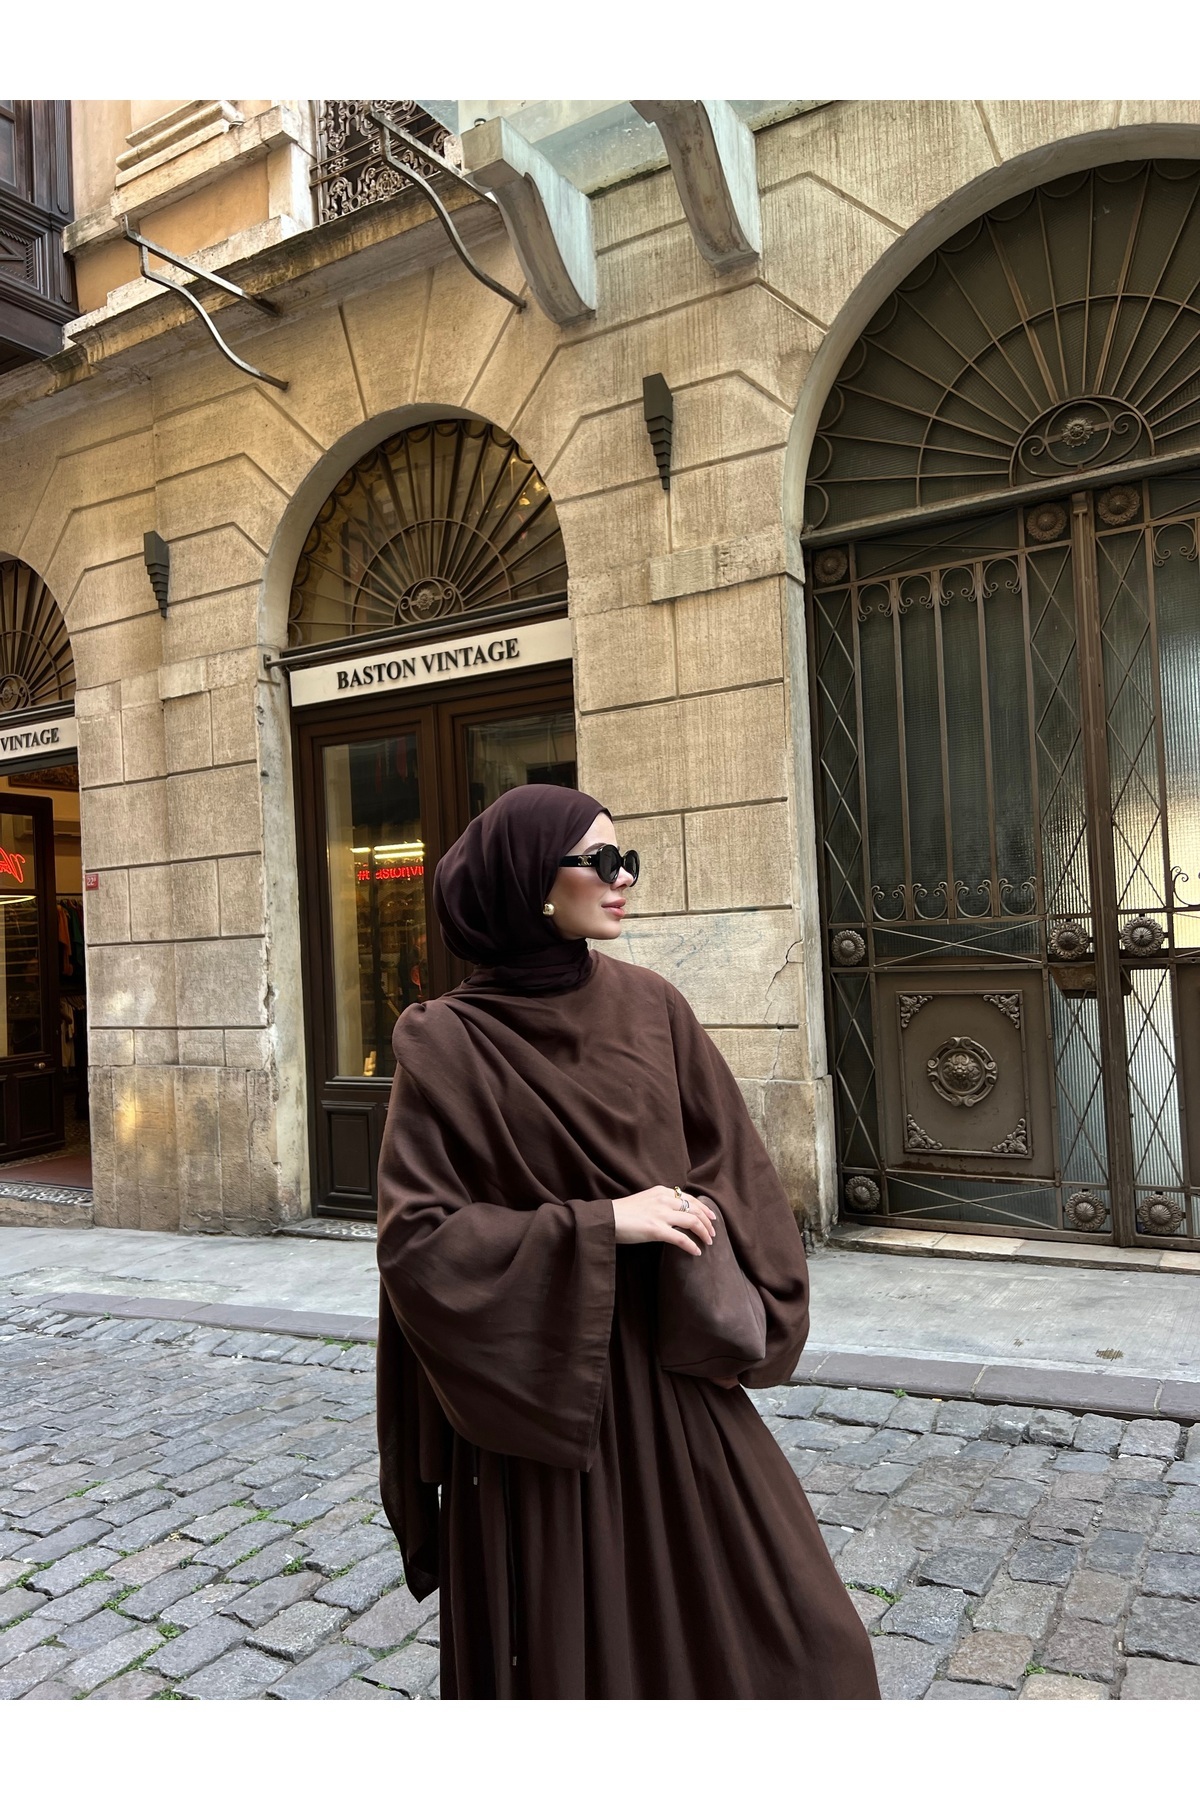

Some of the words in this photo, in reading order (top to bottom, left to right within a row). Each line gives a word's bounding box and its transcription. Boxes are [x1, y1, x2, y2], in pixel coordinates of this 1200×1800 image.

[336, 657, 416, 690] BASTON
[421, 637, 520, 674] VINTAGE
[0, 727, 60, 752] VINTAGE
